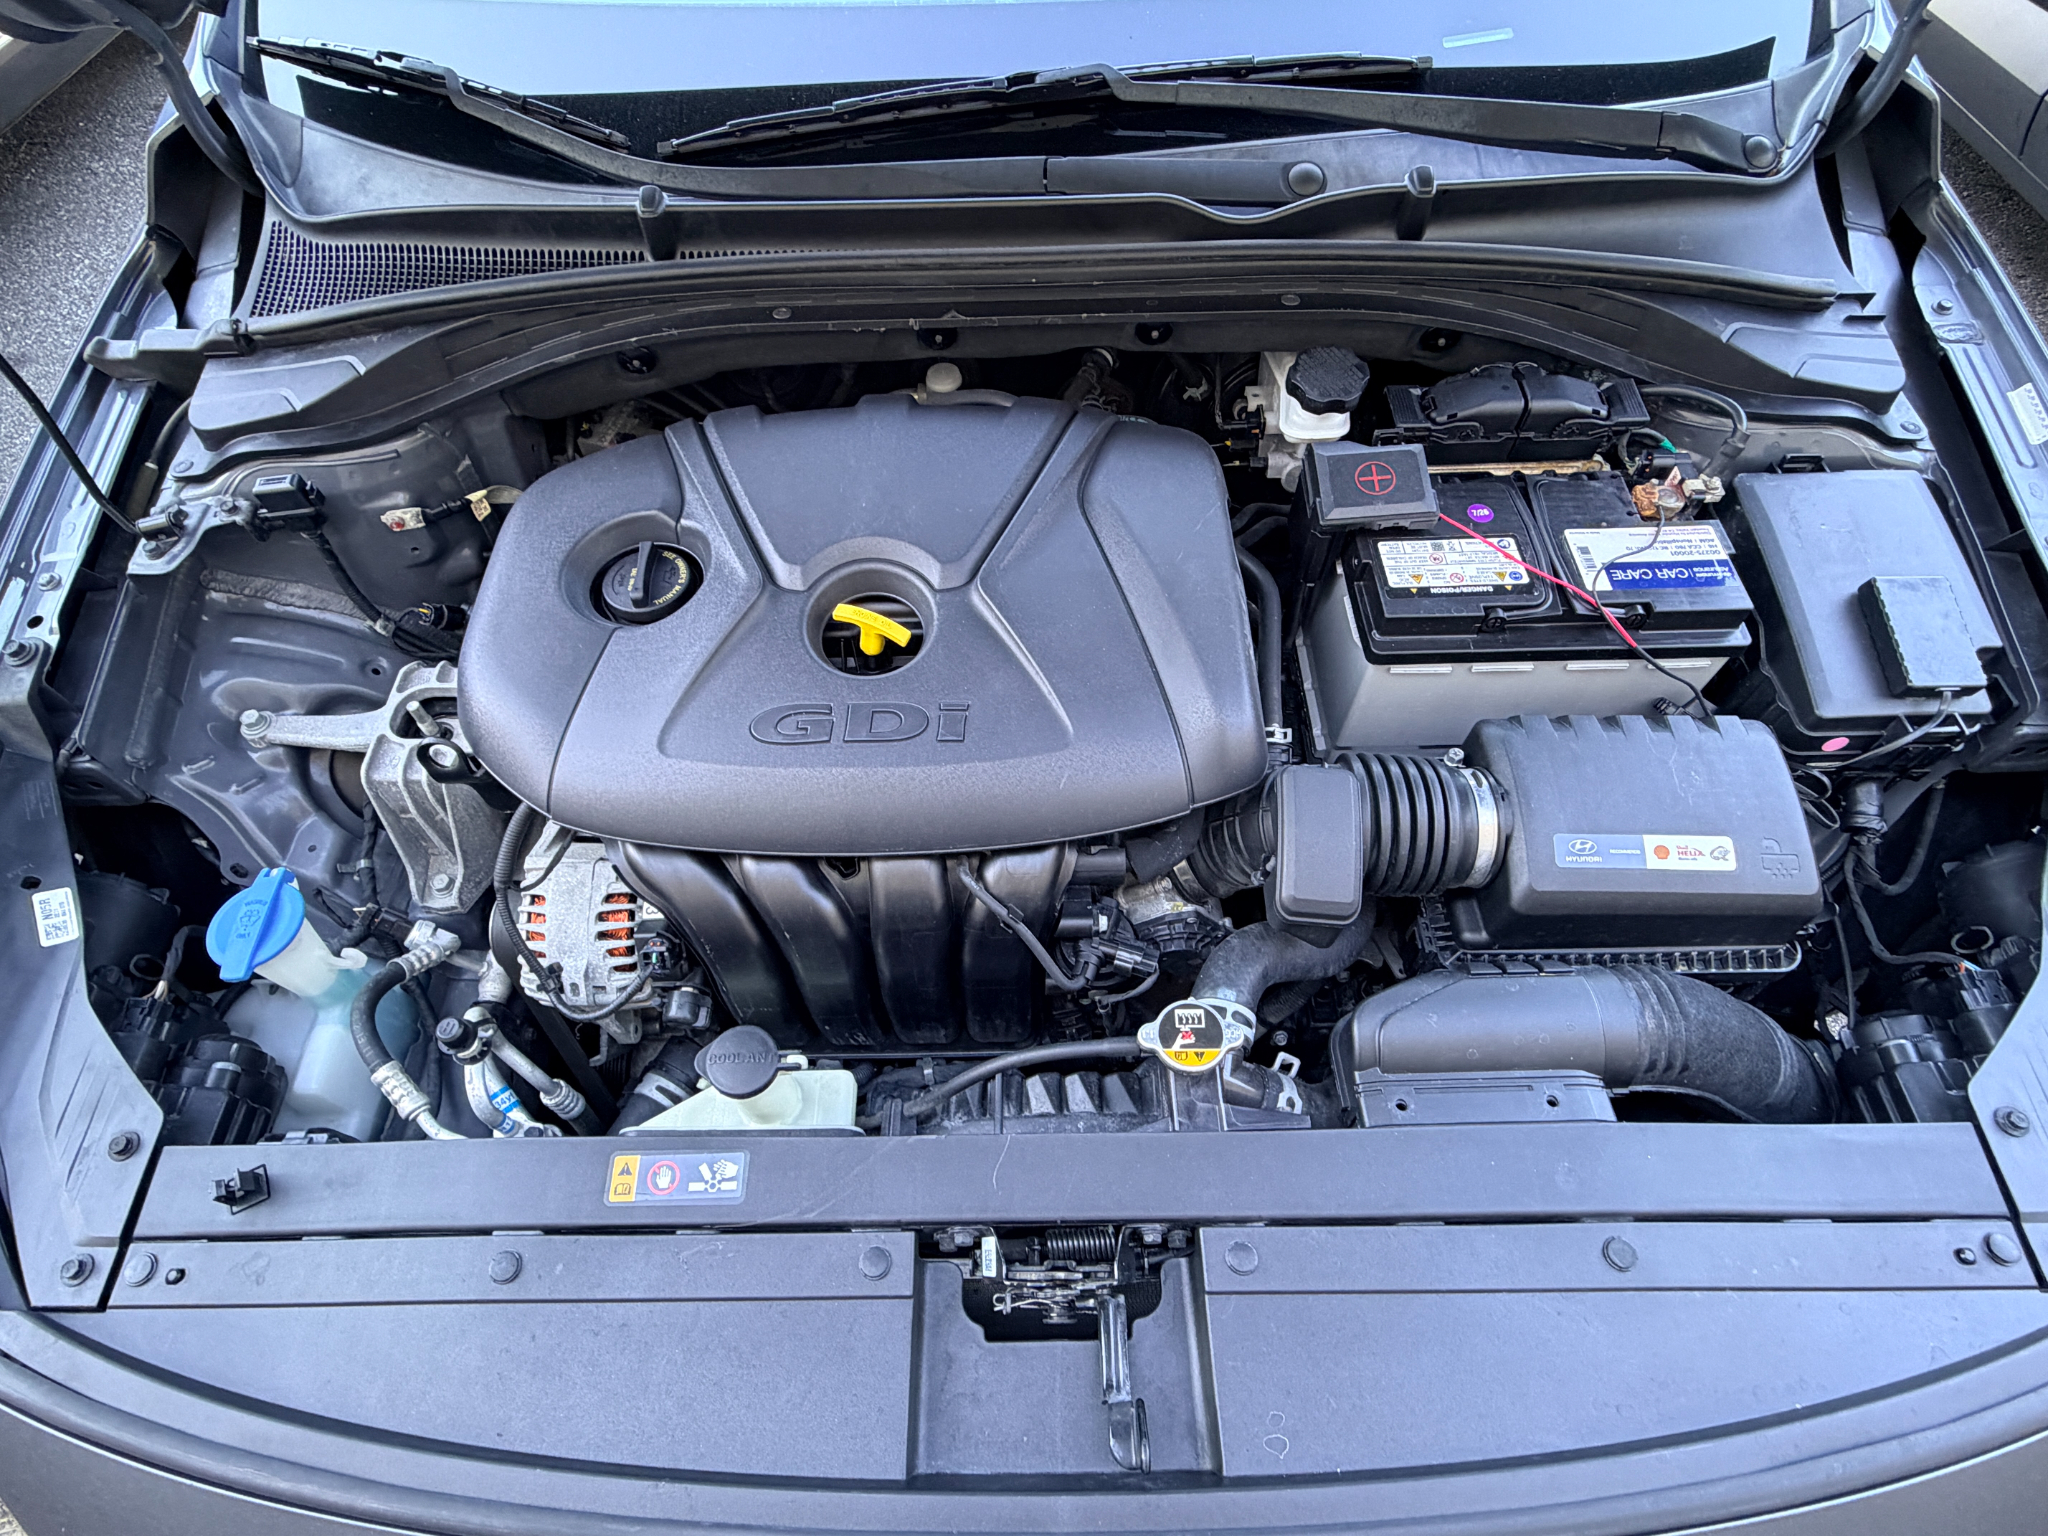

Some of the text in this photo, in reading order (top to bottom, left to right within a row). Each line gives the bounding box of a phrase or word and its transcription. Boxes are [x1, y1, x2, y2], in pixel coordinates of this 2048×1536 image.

[1609, 567, 1689, 580] CAR CARE
[653, 585, 682, 605] MANUAL
[1565, 855, 1603, 863] HYUNDAI
[708, 1052, 777, 1065] COOLANT
